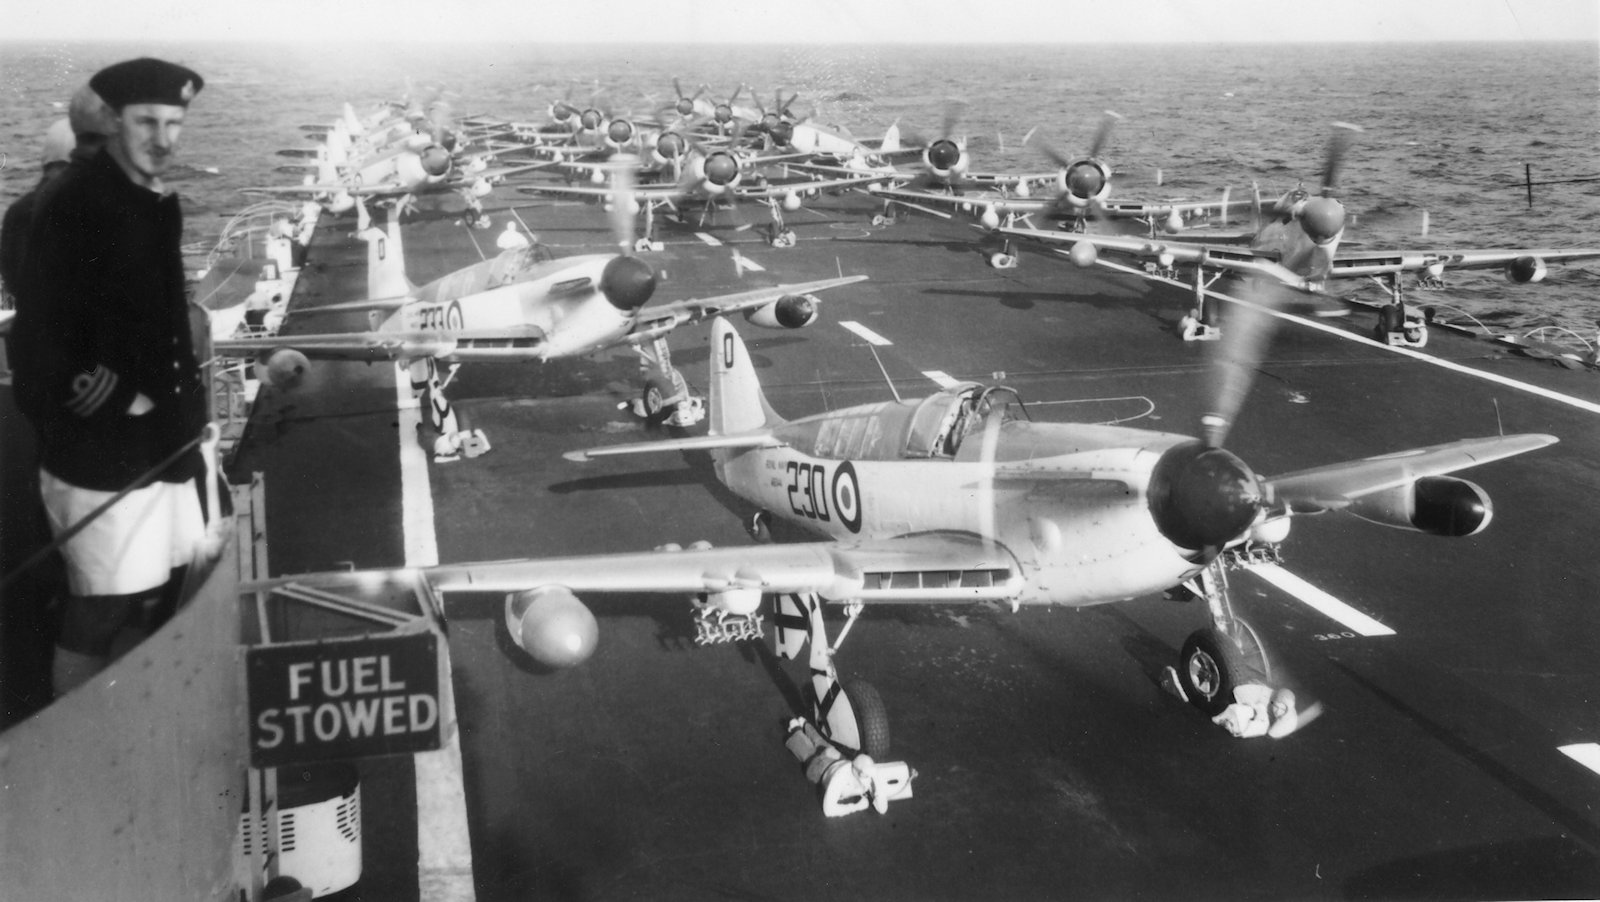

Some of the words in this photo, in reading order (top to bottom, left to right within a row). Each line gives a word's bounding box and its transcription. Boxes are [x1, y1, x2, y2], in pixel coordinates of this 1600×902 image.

[786, 460, 830, 522] 230
[288, 655, 406, 700] FUEL
[257, 693, 438, 749] STOWED
